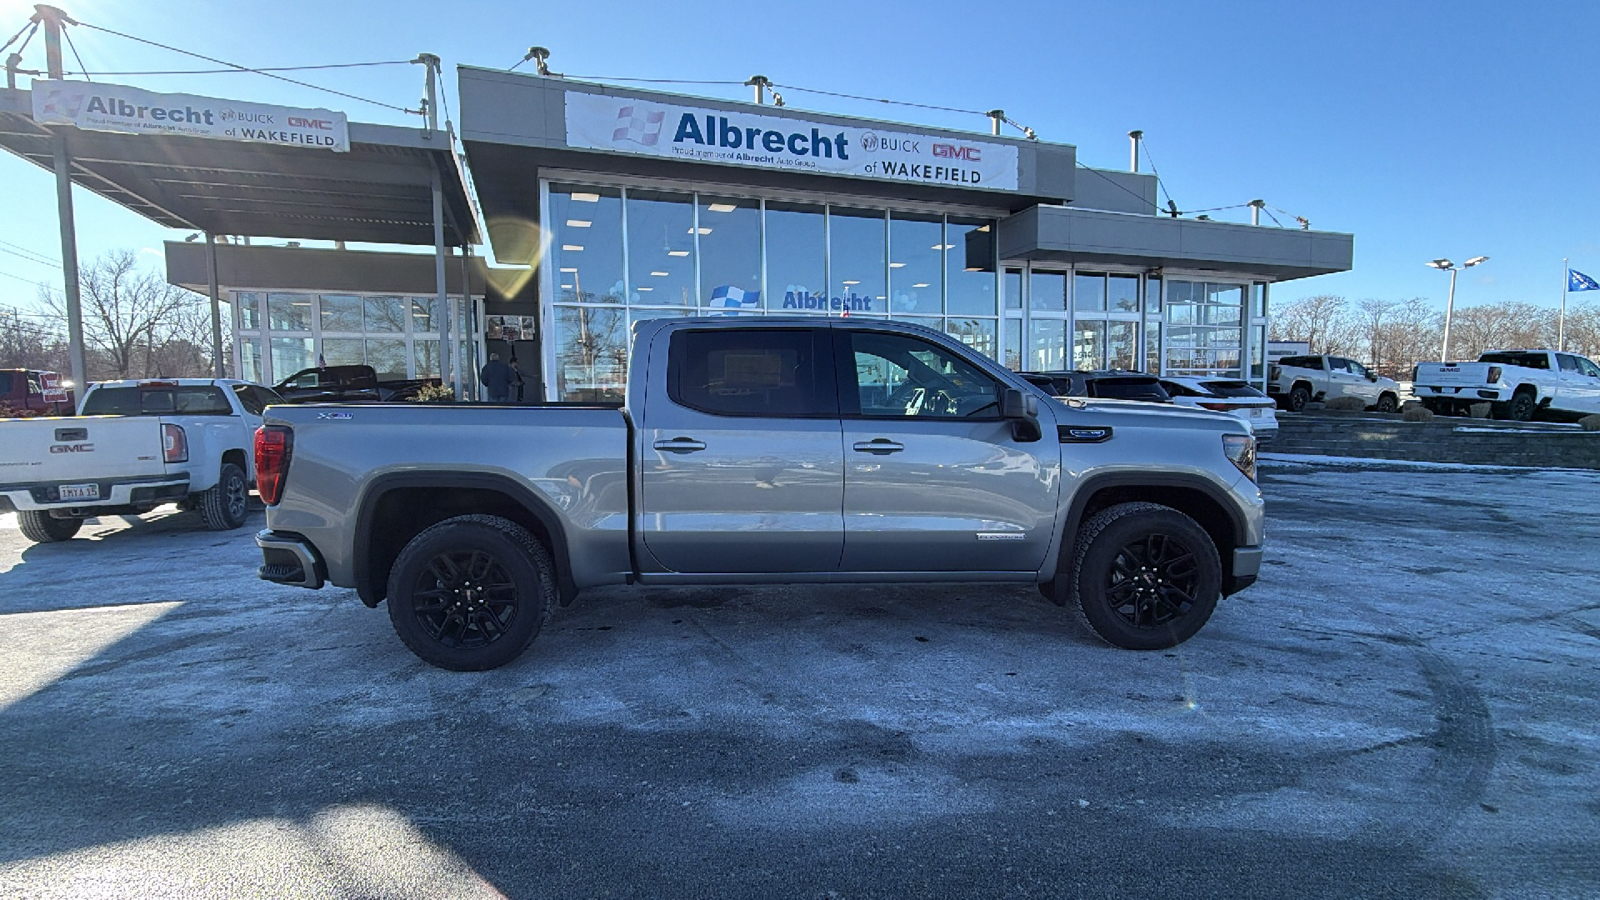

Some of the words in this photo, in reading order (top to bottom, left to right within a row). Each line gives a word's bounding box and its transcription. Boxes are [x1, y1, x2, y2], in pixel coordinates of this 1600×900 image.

[86, 96, 214, 126] Albrecht
[238, 111, 274, 124] BUICK
[287, 116, 333, 131] GMC
[224, 127, 236, 137] of
[241, 127, 335, 146] WAKEFIELD
[672, 112, 849, 161] Albrecht
[881, 137, 920, 154] BUICK
[671, 146, 694, 156] Proud
[695, 149, 725, 159] member
[725, 151, 735, 159] of
[735, 152, 775, 164] Albrecht
[776, 156, 794, 166] Auto
[794, 158, 816, 168] Group
[932, 142, 982, 163] GMC
[864, 161, 878, 174] of
[882, 160, 982, 184] WAKEFIELD
[49, 443, 95, 454] GMC
[86, 487, 98, 497] 15
